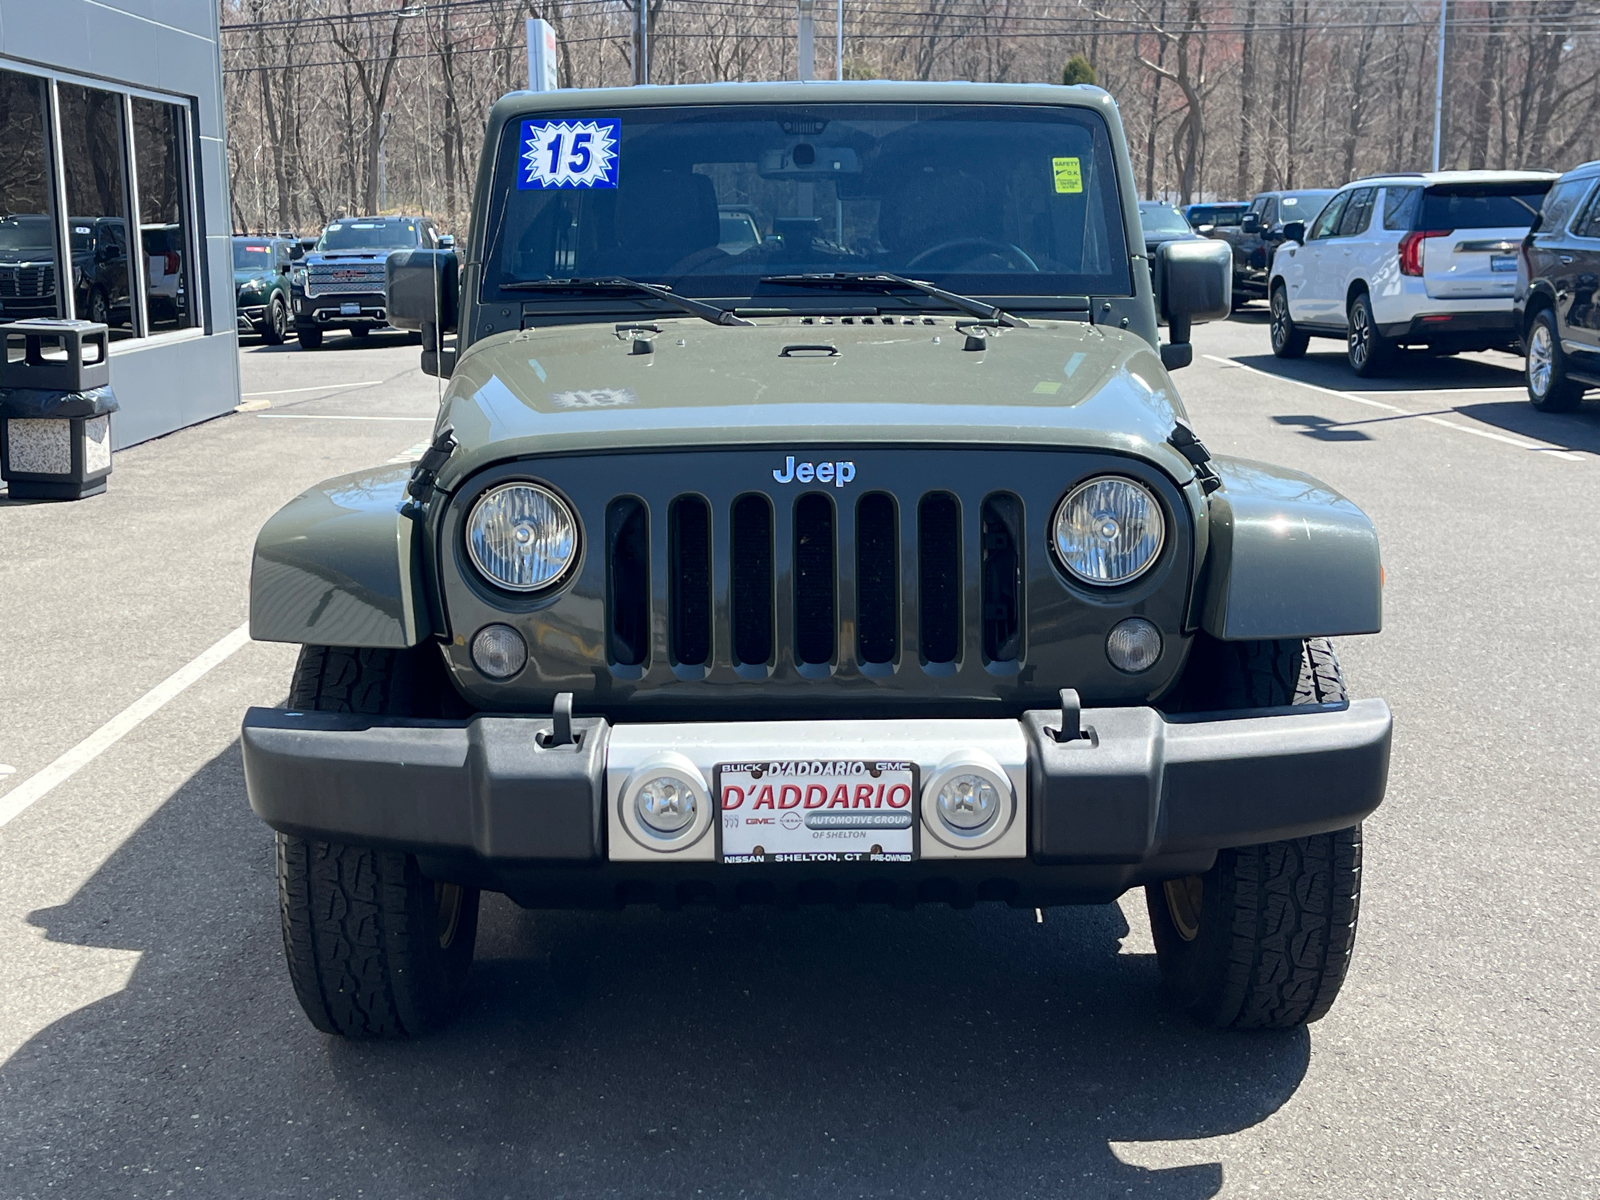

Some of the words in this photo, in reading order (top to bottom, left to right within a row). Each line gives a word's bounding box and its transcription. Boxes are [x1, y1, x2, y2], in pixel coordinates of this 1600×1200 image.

[547, 133, 592, 174] 15
[772, 456, 856, 488] Jeep
[722, 763, 762, 772] BUICK
[767, 761, 866, 777] D'ADDARIO
[875, 762, 911, 771] GMC
[721, 784, 911, 810] D'ADDARIO
[745, 817, 776, 825] GMC
[810, 815, 873, 825] AUTOMOTIVE
[874, 815, 908, 824] GROUP
[812, 831, 825, 839] OF
[826, 831, 867, 839] SHELTON
[724, 855, 764, 863] NISSAN
[774, 853, 841, 863] SHELTON,
[844, 853, 863, 862] CT
[870, 854, 912, 862] PRE-OWNED
